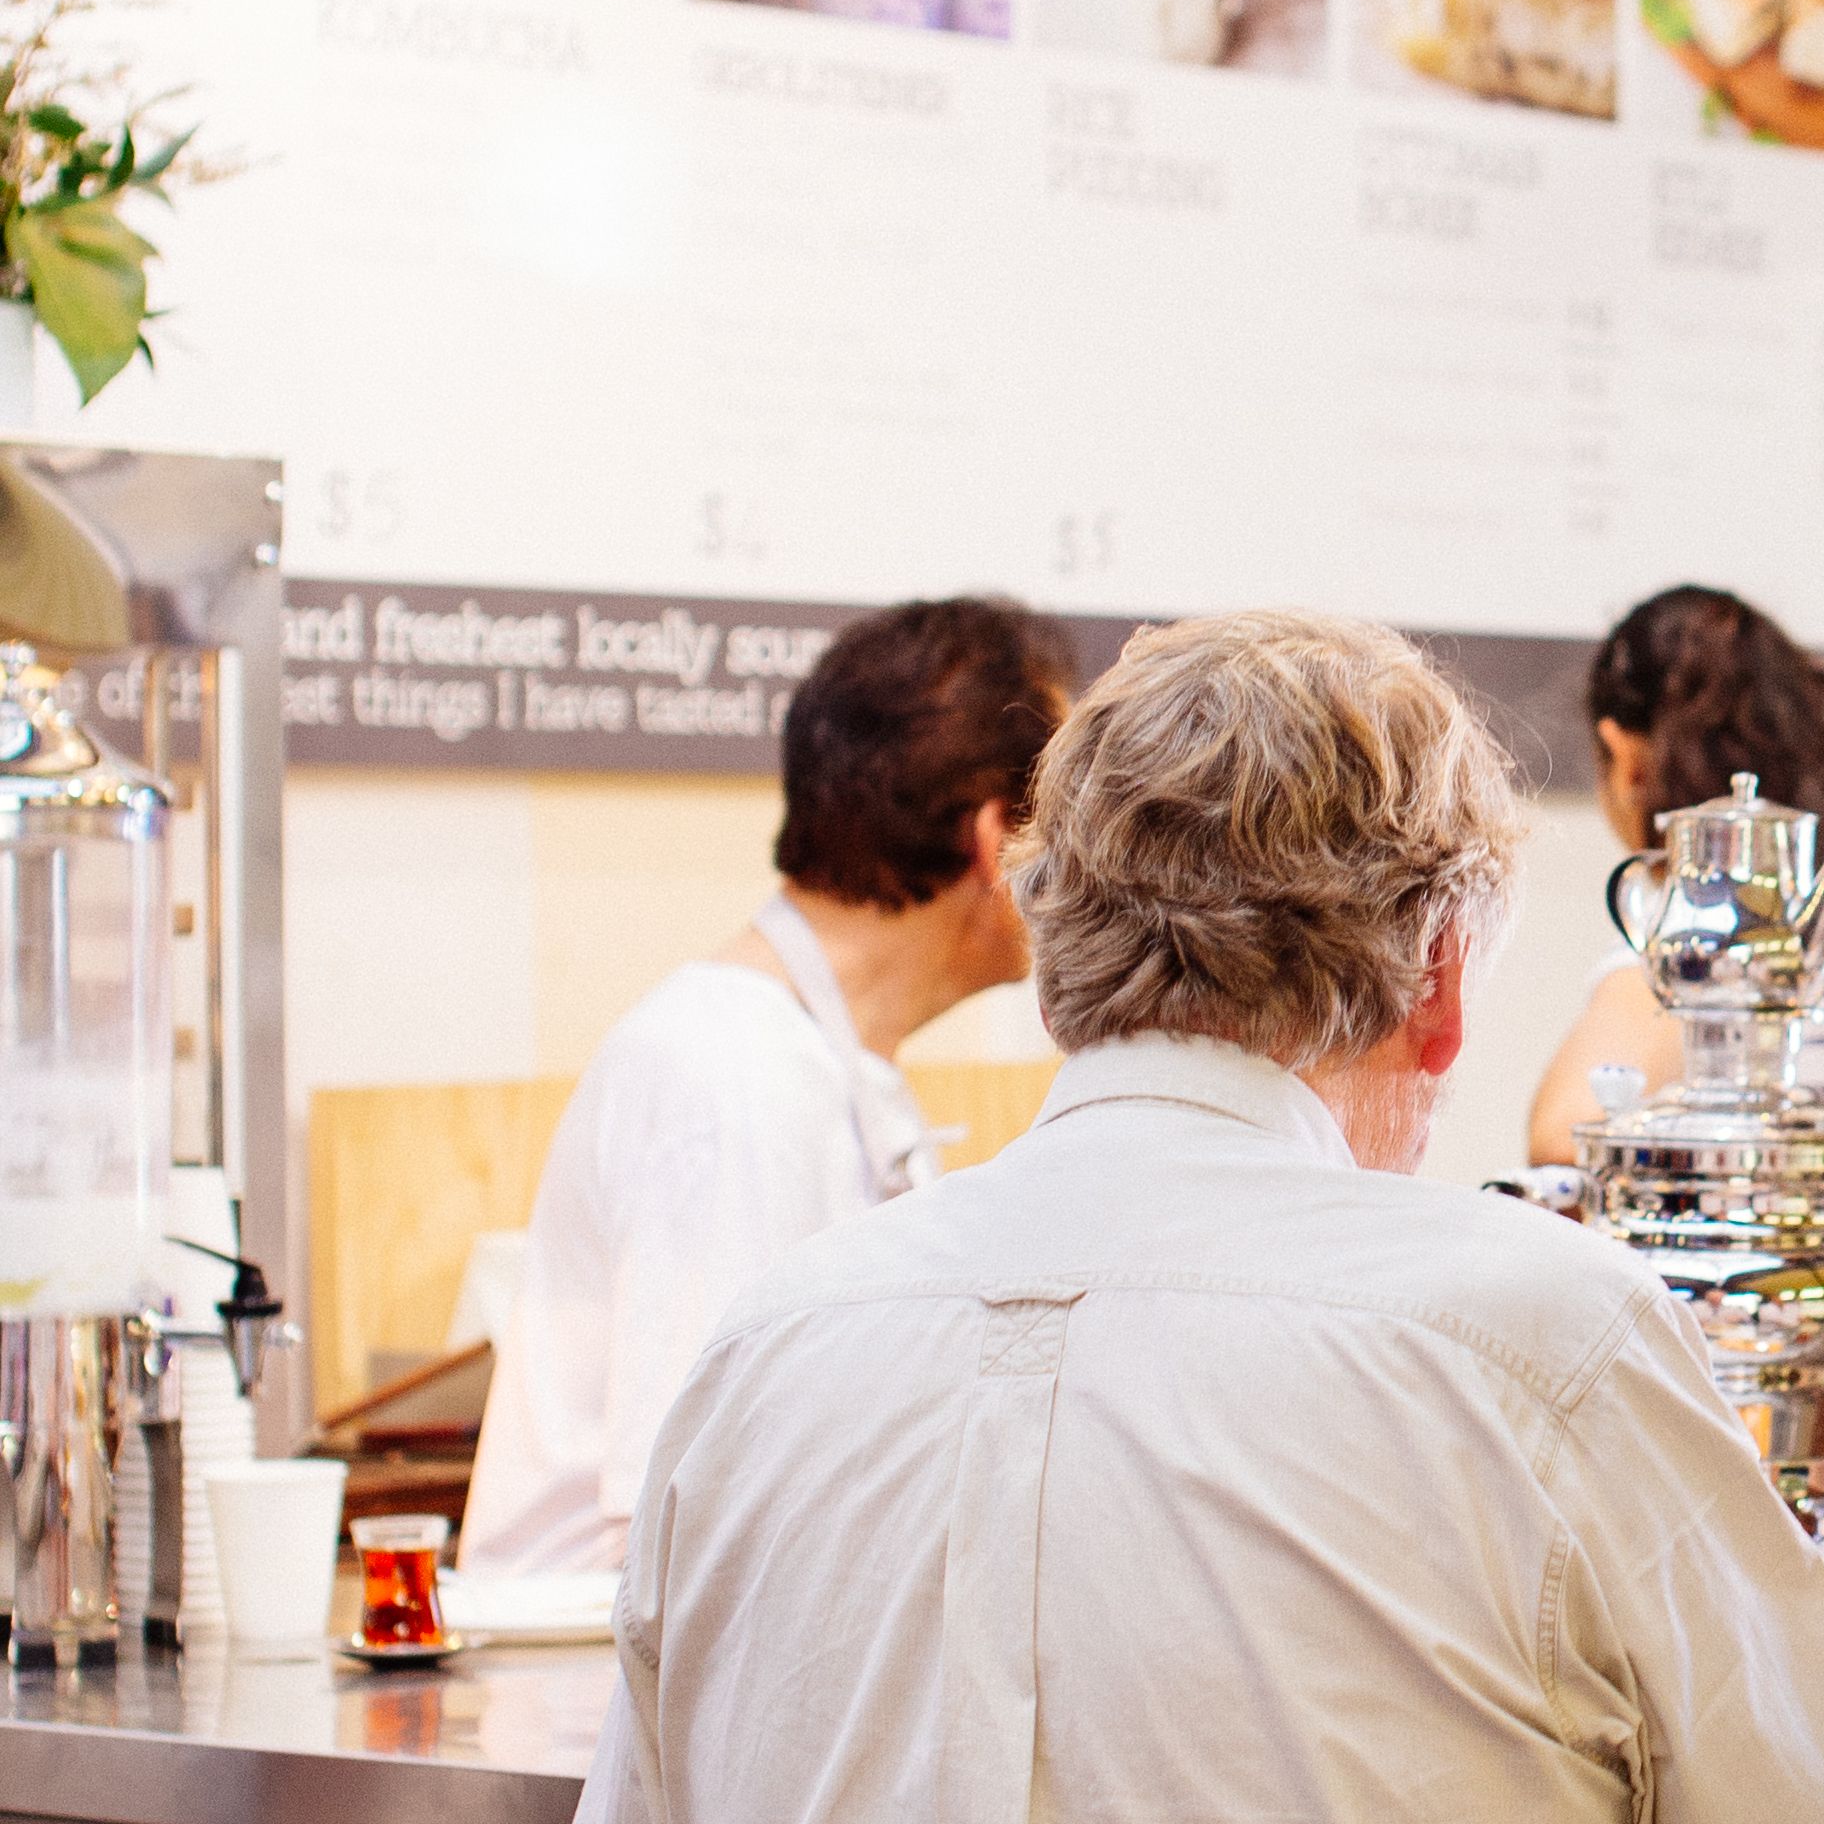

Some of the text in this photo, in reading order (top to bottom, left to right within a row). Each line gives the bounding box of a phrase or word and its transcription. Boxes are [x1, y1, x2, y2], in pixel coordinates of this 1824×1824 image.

[375, 596, 568, 668] freshest
[575, 603, 720, 686] locally
[354, 665, 490, 744] things
[524, 670, 633, 734] have
[635, 677, 766, 737] tasted
